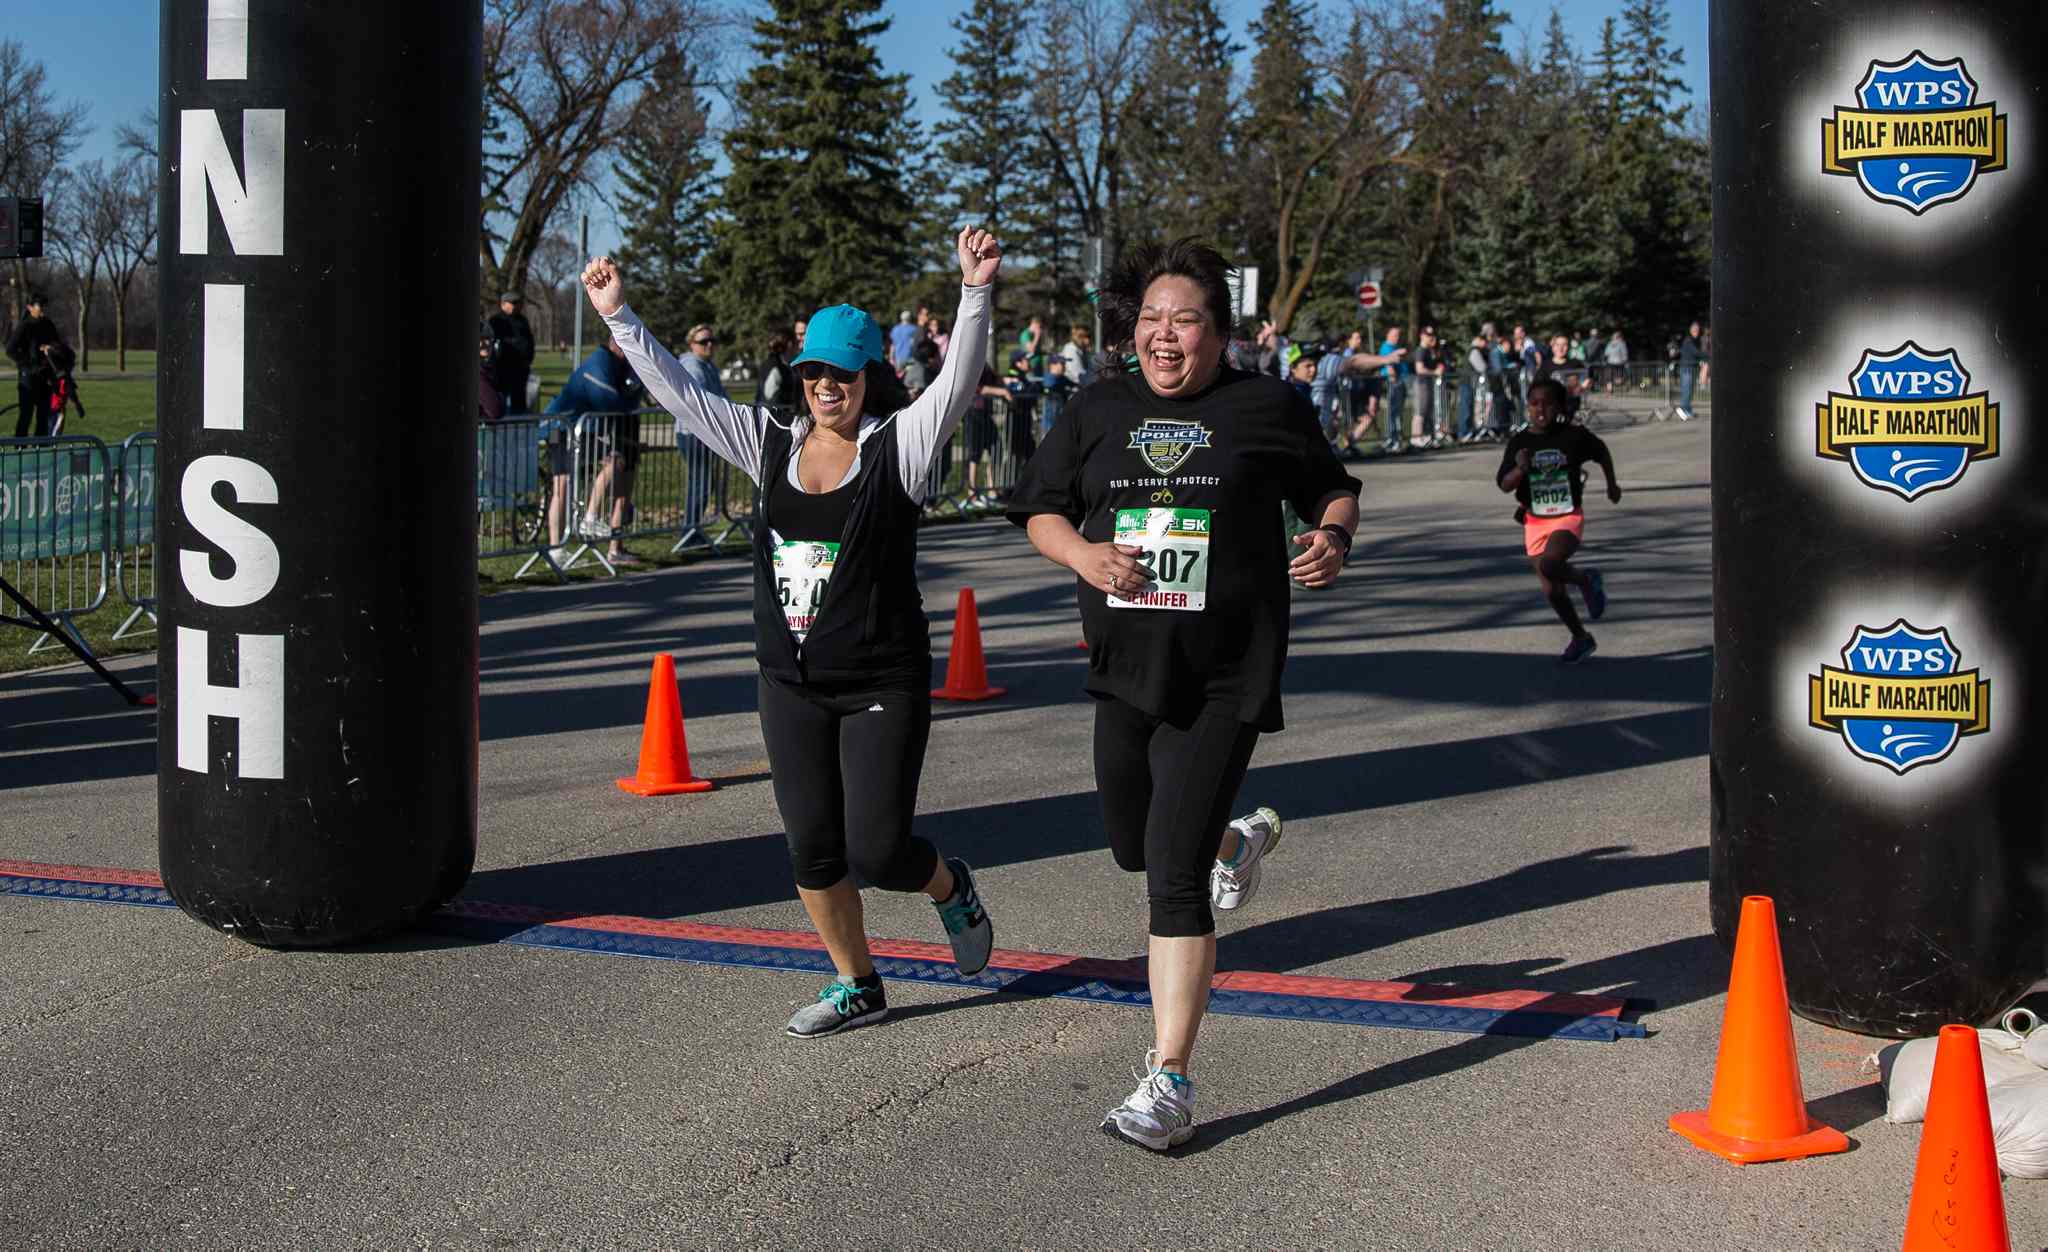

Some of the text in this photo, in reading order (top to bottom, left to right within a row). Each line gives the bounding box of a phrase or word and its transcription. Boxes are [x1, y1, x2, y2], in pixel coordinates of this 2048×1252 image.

[1875, 80, 1962, 107] WPS
[1842, 116, 1988, 150] HALF MARATHON
[1867, 369, 1954, 396] WPS
[1836, 405, 1980, 436] HALF MARATHON
[1141, 430, 1198, 439] POLICE
[1149, 441, 1184, 456] 5K
[1110, 476, 1220, 488] RUN SERVE PROTECT
[1183, 519, 1206, 531] 5K
[1859, 647, 1946, 673] WPS
[1829, 678, 1971, 712] HALF MARATHON
